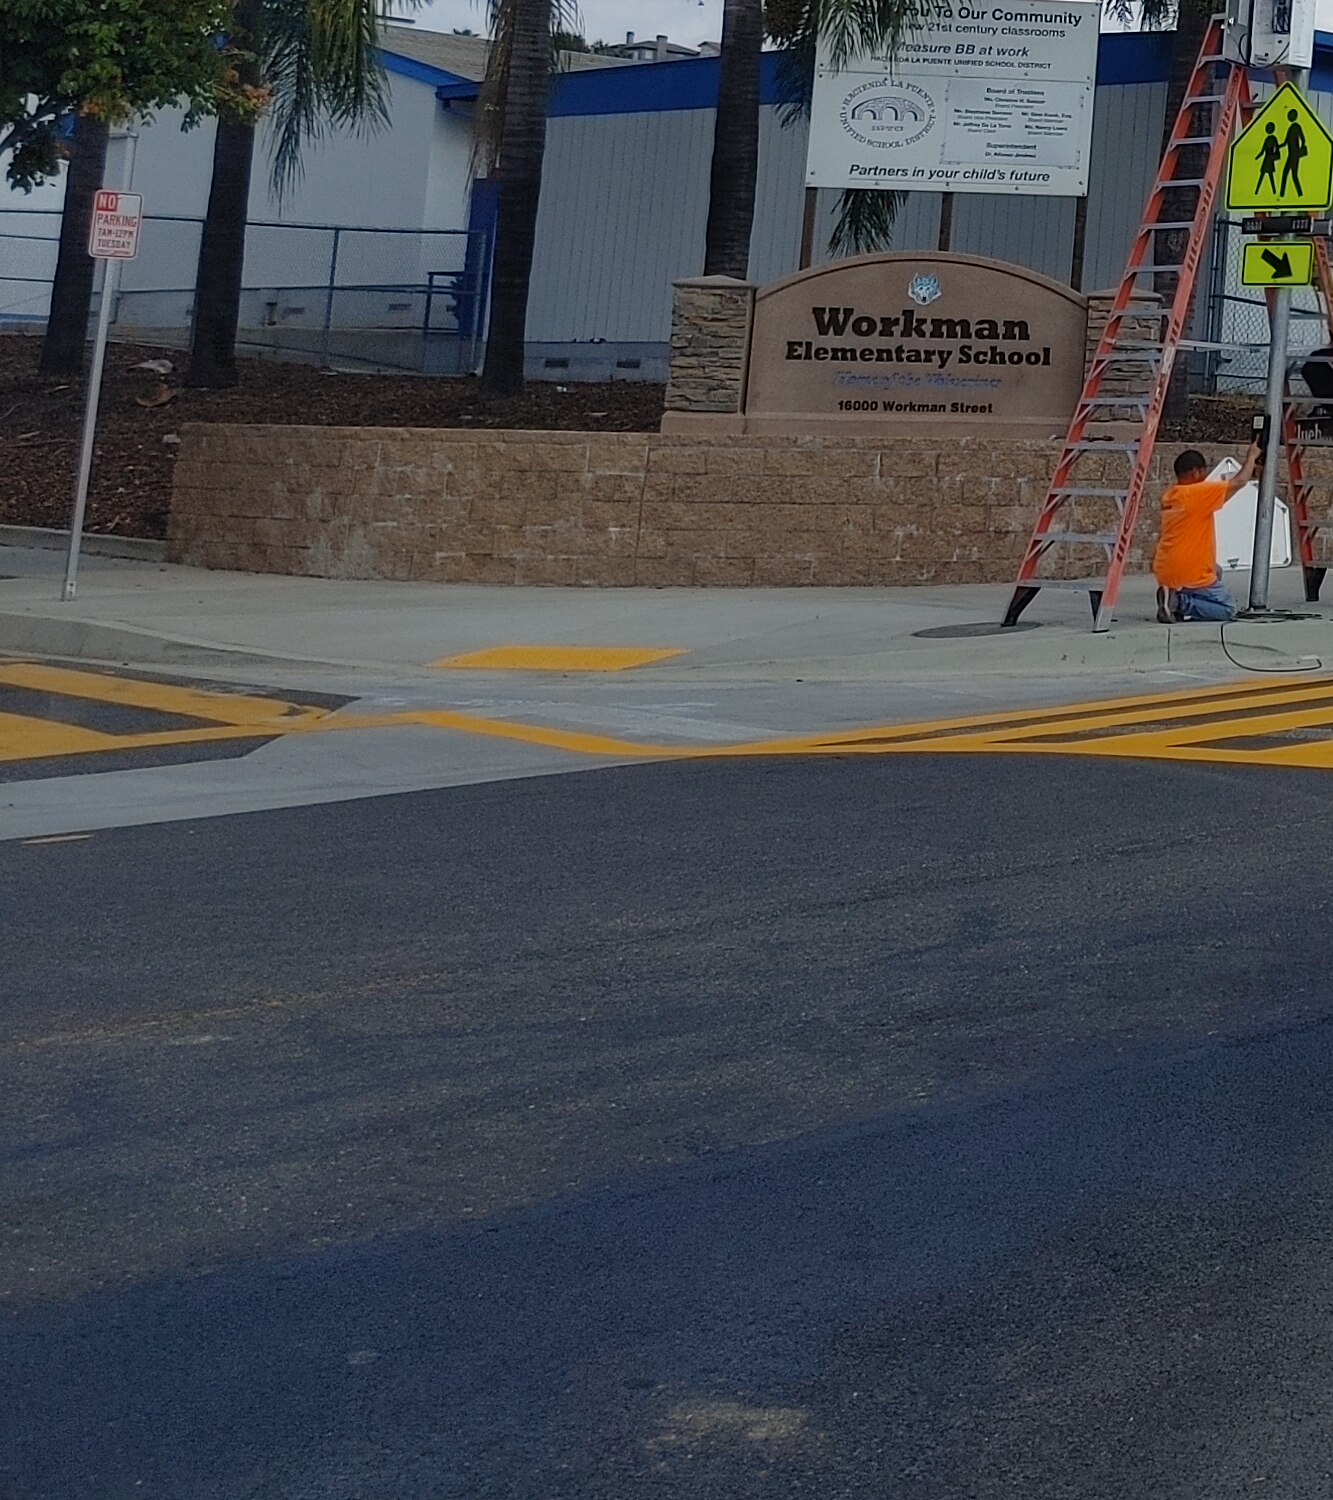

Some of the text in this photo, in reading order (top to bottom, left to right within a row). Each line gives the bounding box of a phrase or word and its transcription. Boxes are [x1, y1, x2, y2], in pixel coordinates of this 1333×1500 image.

[934, 5, 953, 19] To
[958, 7, 988, 20] Our
[992, 8, 1082, 27] Community
[928, 21, 952, 32] 21st
[955, 24, 998, 36] century
[1001, 26, 1066, 38] classrooms
[955, 44, 976, 55] BB
[979, 45, 993, 56] at
[997, 47, 1030, 57] work
[954, 59, 984, 67] UNIFIED
[985, 60, 1016, 68] SCHOOL
[849, 164, 1051, 182] Partners in your child's future
[99, 194, 116, 209] NO
[97, 213, 137, 227] PARKING
[98, 239, 131, 249] TUESDAY
[812, 306, 1031, 341] Workman
[785, 341, 1051, 369] Elementary School
[837, 400, 993, 413] 16000 Workman Street
